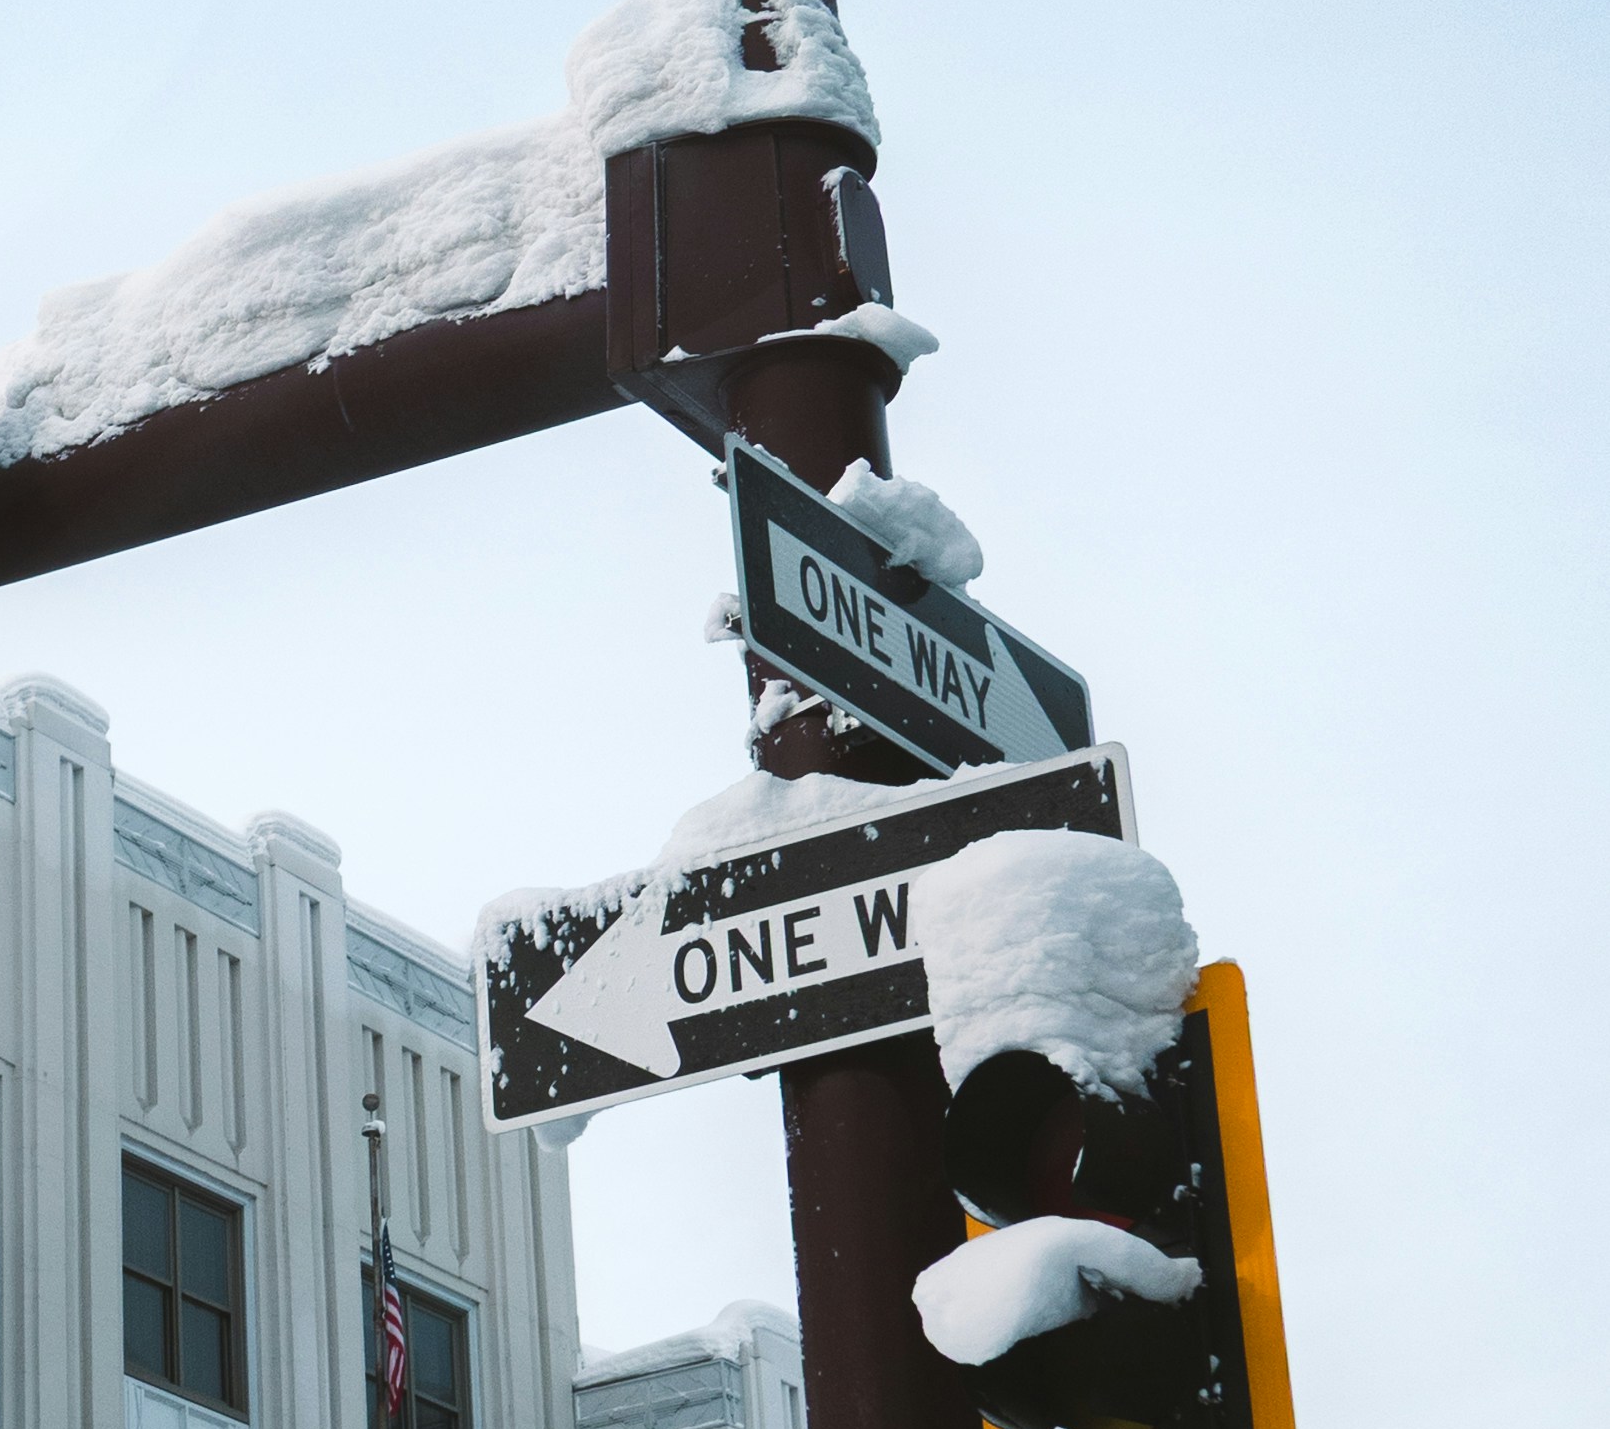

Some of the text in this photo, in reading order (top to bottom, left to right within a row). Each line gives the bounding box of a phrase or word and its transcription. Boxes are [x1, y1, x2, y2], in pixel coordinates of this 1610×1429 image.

[799, 554, 991, 730] ONE WAY
[673, 905, 828, 1004] ONE
